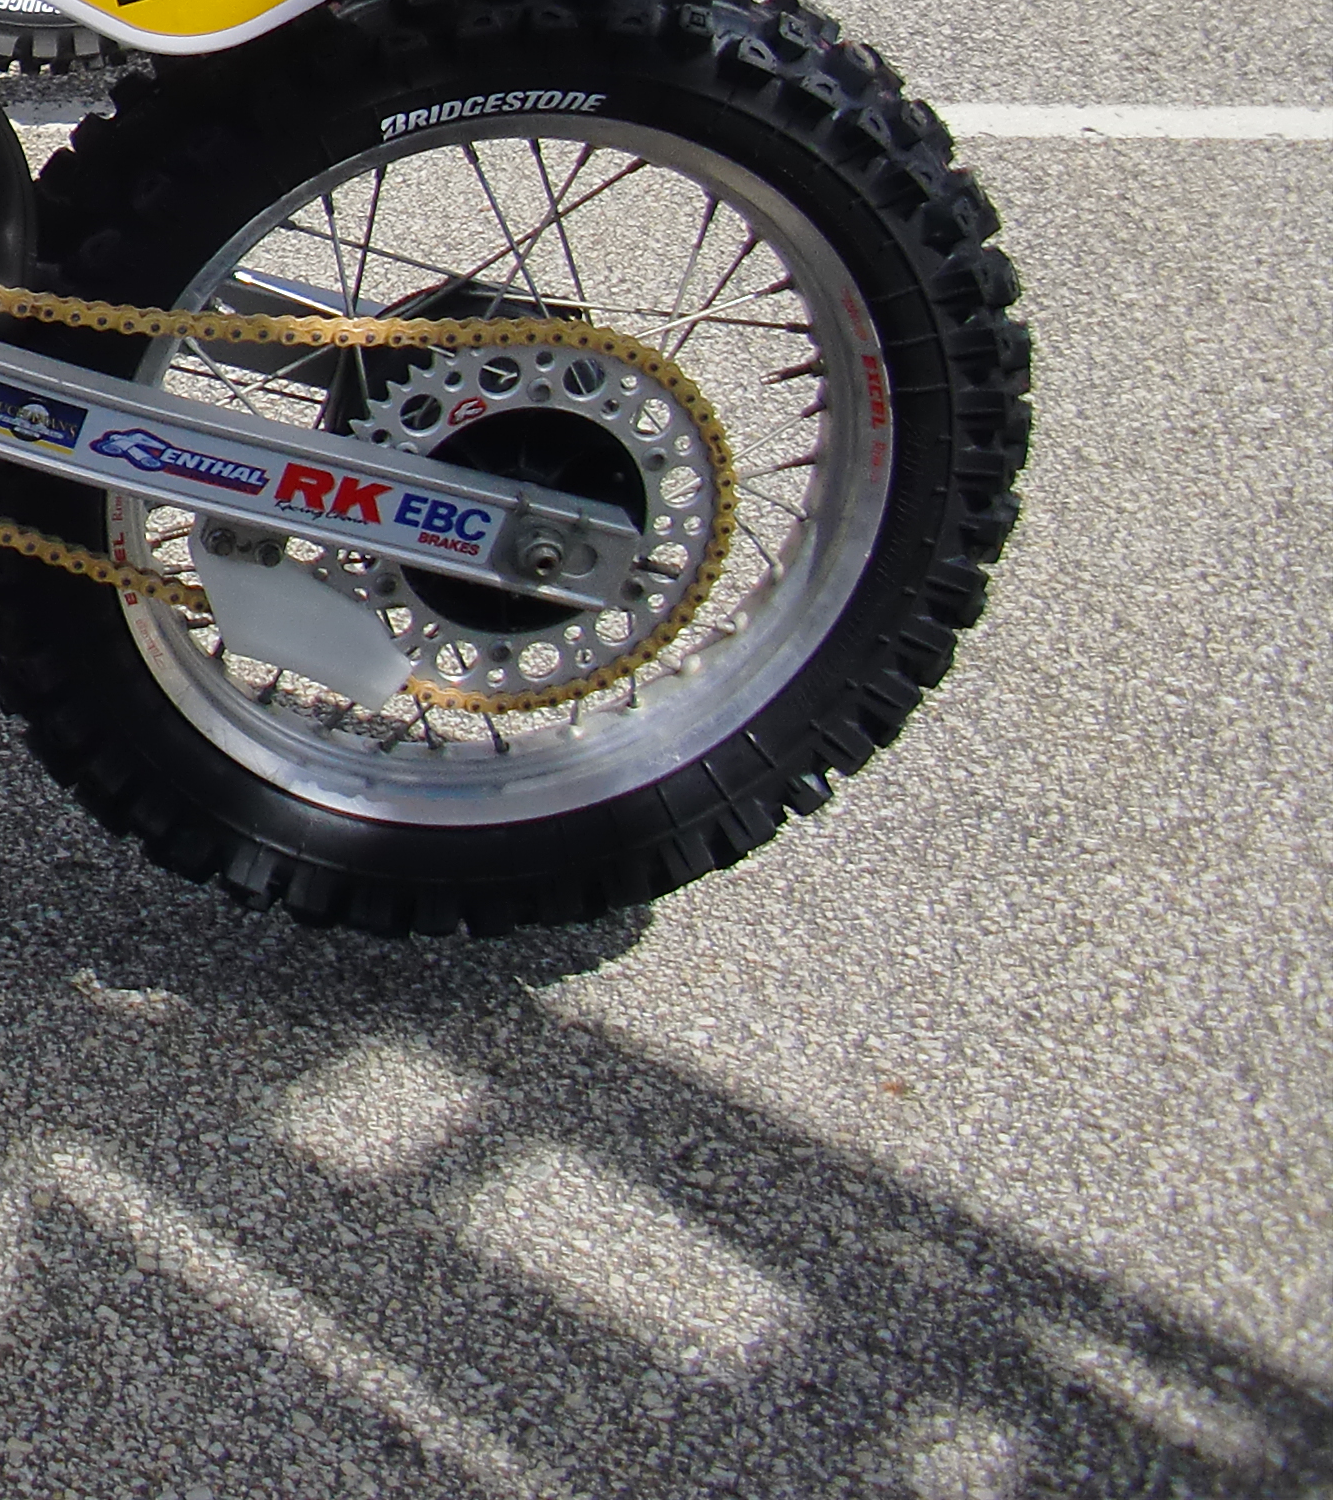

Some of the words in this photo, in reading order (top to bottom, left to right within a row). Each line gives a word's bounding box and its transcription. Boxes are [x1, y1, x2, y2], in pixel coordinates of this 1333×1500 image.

[380, 88, 607, 142] BRIDGESTONE
[861, 354, 890, 430] EXCEL
[273, 462, 394, 526] RK
[393, 492, 492, 542] EBC
[417, 530, 480, 557] BRAKES
